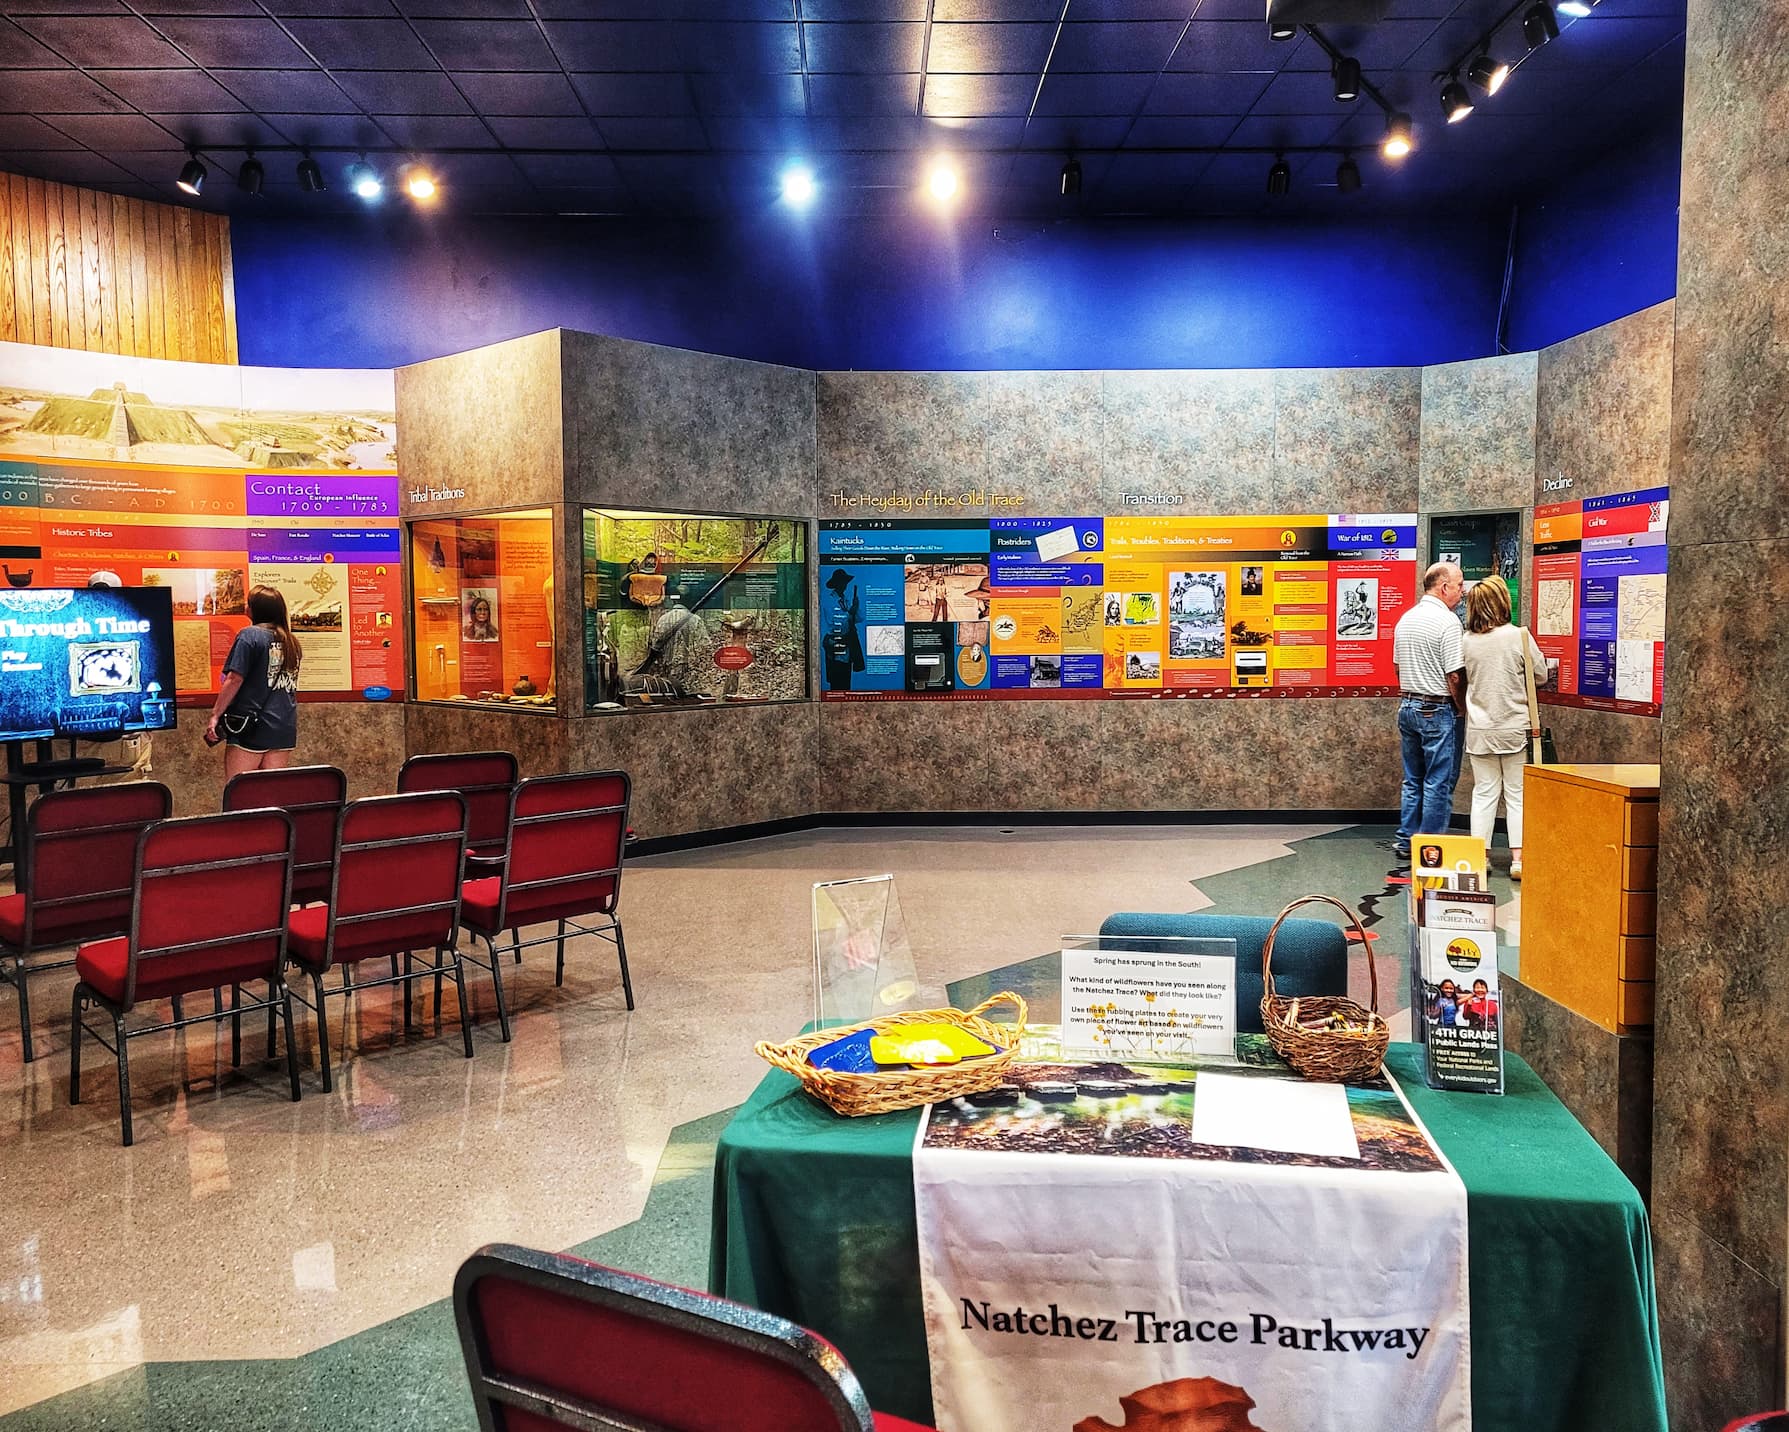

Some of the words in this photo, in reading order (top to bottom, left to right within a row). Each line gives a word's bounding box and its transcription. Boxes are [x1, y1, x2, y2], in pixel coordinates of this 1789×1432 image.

[1543, 472, 1574, 491] Decline
[250, 482, 321, 496] Contact
[408, 485, 429, 504] Tribal
[429, 482, 465, 501] Traditions
[309, 495, 344, 503] European
[346, 494, 379, 502] Influence
[830, 489, 857, 506] The
[860, 489, 913, 513] Heyday
[915, 489, 932, 507] of
[933, 489, 957, 506] the
[958, 489, 985, 506] Old
[988, 493, 1025, 506] Trace
[1118, 491, 1183, 505] Transition
[281, 501, 323, 513] 1700
[352, 502, 388, 513] 1783
[52, 527, 86, 537] Historic
[88, 528, 113, 538] Tribes
[1337, 534, 1350, 542] War
[1352, 532, 1360, 542] of
[830, 535, 865, 545] Kaintucks
[996, 536, 1032, 546] Postriders
[1206, 537, 1233, 545] Treaties
[300, 553, 322, 563] England
[352, 568, 369, 576] One
[353, 616, 368, 625] Led
[0, 617, 92, 639] Through
[95, 616, 150, 634] Time
[354, 628, 385, 637] Another
[1094, 957, 1116, 966] Spring
[1117, 957, 1130, 965] has
[1131, 959, 1155, 967] sprung
[1089, 976, 1104, 984] kind
[1114, 978, 1154, 986] wildflowers
[1139, 989, 1158, 997] What
[1172, 991, 1187, 999] they
[1188, 991, 1204, 999] look
[1205, 992, 1222, 1000] like?
[1107, 1007, 1133, 1016] rubbing
[1135, 1009, 1157, 1017] plates
[1086, 1017, 1105, 1025] piece
[1115, 1018, 1137, 1026] flower
[1183, 1022, 1224, 1030] wildflowers
[1435, 1028, 1457, 1038] 4TH
[1459, 1029, 1498, 1041] GRADE
[1435, 1039, 1458, 1047] Public
[1459, 1040, 1481, 1048] Lands
[960, 1297, 1118, 1342] Natchez
[1125, 1310, 1238, 1344] Trace
[1249, 1313, 1431, 1359] Parkway
